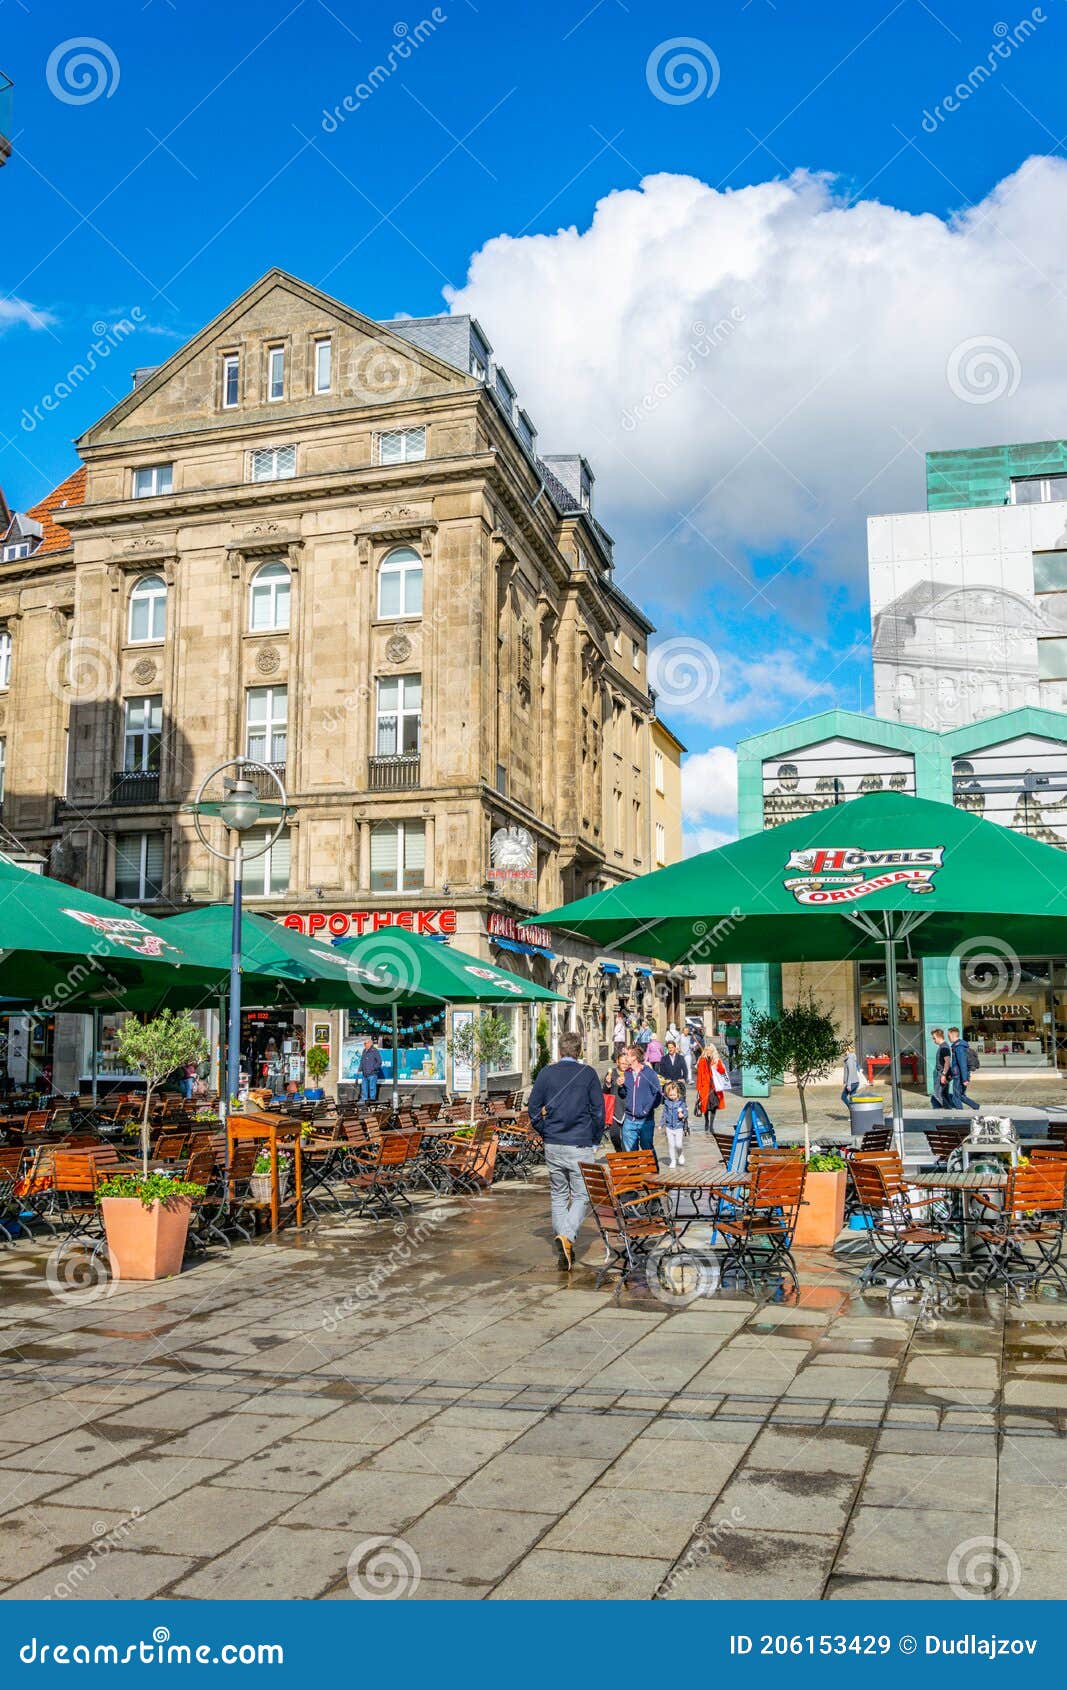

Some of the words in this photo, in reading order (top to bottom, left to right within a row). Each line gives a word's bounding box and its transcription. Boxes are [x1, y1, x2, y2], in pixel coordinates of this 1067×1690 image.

[811, 850, 933, 874] HÖVELS
[808, 871, 927, 902] ORIGINAL
[284, 909, 458, 936] APOTHEKE
[981, 1004, 1031, 1016] PIORS
